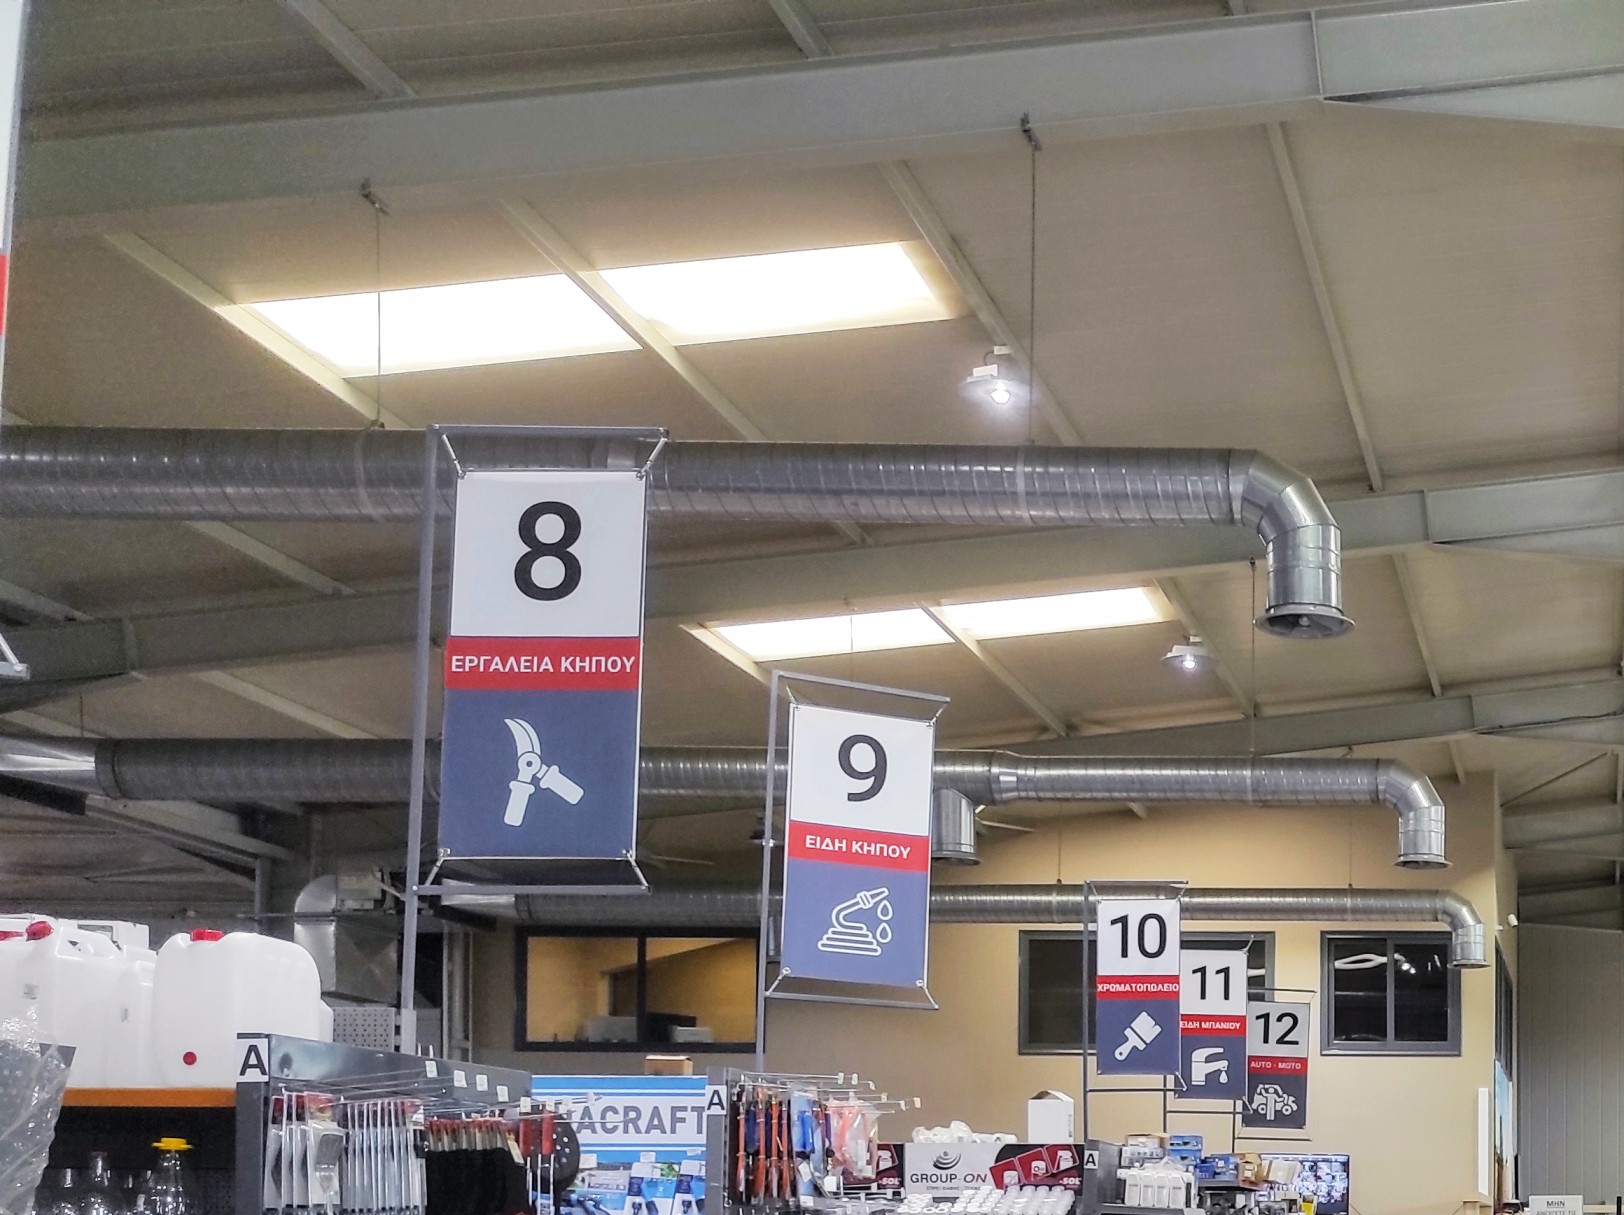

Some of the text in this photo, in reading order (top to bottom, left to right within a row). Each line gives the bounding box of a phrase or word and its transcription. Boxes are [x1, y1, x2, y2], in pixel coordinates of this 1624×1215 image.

[514, 501, 582, 601] 8
[451, 656, 636, 673] ΕΡΓΑΛΕΙΑ ΚΗΠΟΥ
[837, 734, 888, 802] 9
[805, 835, 911, 860] ΕΙΔΗ ΚΗΠΟΥ
[1110, 913, 1167, 959] 10
[1097, 983, 1179, 992] ΧΡΩΜΑΤΟΠΩΛΕΙΟ
[1191, 965, 1230, 1000] 11
[1181, 1021, 1241, 1030] ΕΙΔΗ ΜΠΑΝΙΟΥ
[1255, 1012, 1300, 1045] 12
[239, 1045, 268, 1077] A
[1278, 1062, 1301, 1070] MOTO
[707, 1089, 725, 1111] A
[1085, 1153, 1096, 1166] A
[910, 1173, 987, 1184] GROUP-ON
